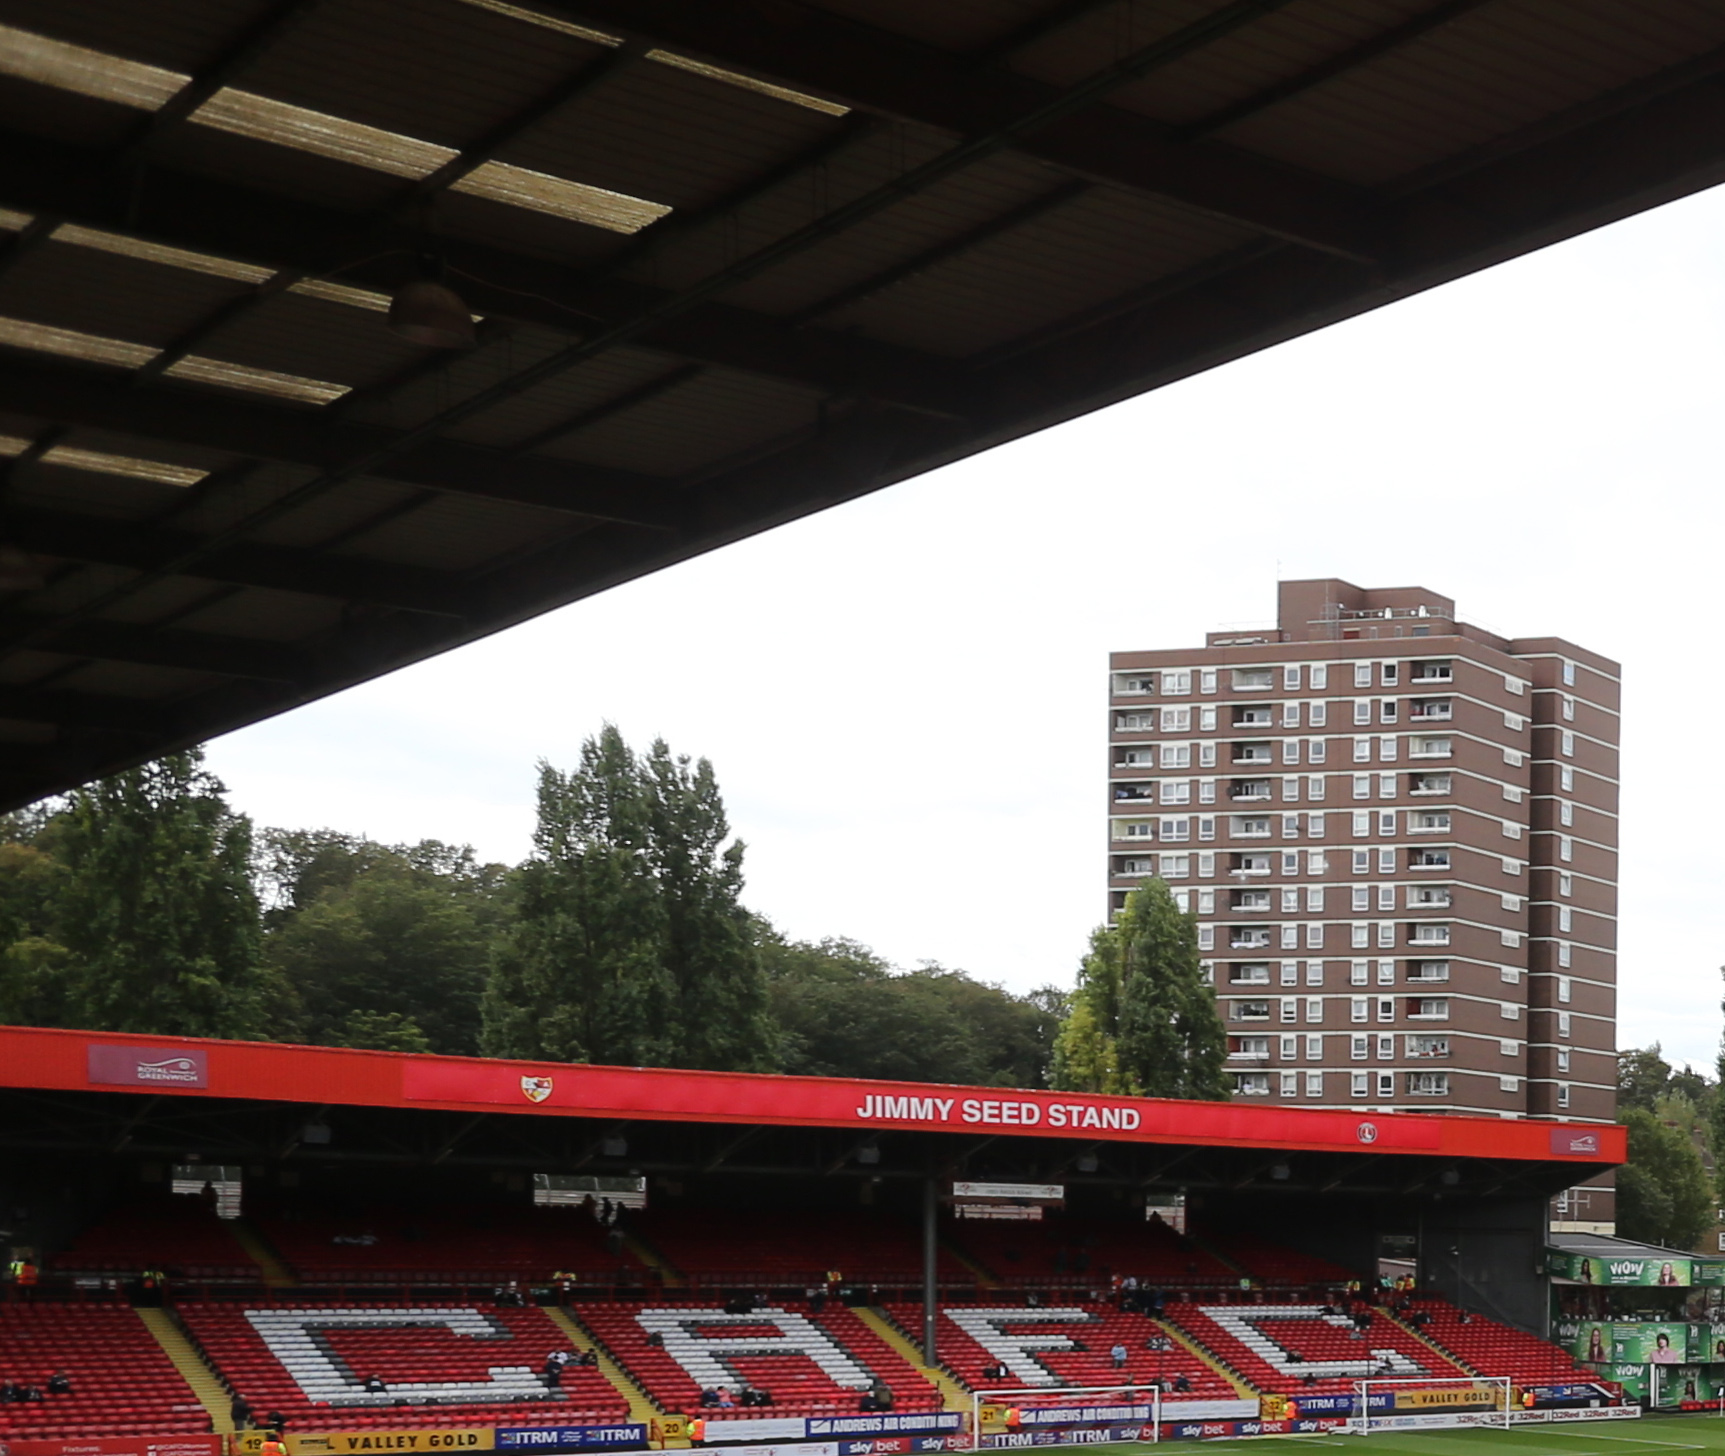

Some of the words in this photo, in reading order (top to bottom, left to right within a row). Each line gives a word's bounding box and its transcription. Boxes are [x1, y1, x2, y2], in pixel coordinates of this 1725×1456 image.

[856, 1094, 954, 1121] JIMMY
[962, 1099, 1041, 1125] SEED
[1047, 1104, 1141, 1130] STAND
[1421, 1392, 1461, 1403] VALLEY
[1464, 1391, 1490, 1401] GOLD
[983, 1411, 994, 1420] 21
[1037, 1409, 1081, 1423] ANDREWS
[1553, 1410, 1580, 1419] 32Red
[1583, 1409, 1609, 1418] 32Red
[1612, 1407, 1638, 1416] 32Red
[664, 1423, 679, 1433] 20
[832, 1416, 883, 1433] ANDREWS
[883, 1415, 899, 1431] AIR
[1182, 1424, 1201, 1436] sky
[1204, 1422, 1225, 1434] bet
[1242, 1421, 1260, 1433] sky
[1263, 1420, 1283, 1432] bet
[1300, 1420, 1318, 1431] sky
[516, 1431, 558, 1444] ITRM
[600, 1428, 640, 1441] ITRM
[995, 1433, 1033, 1448] ITRM
[1072, 1429, 1110, 1443] ITRM
[1120, 1427, 1141, 1439] sky
[245, 1438, 262, 1450] 19
[348, 1435, 418, 1449] VALLEY
[429, 1434, 478, 1448] GOLD
[849, 1442, 873, 1454] sky
[876, 1440, 900, 1451] bet
[921, 1438, 944, 1450] sky
[947, 1437, 970, 1448] bet
